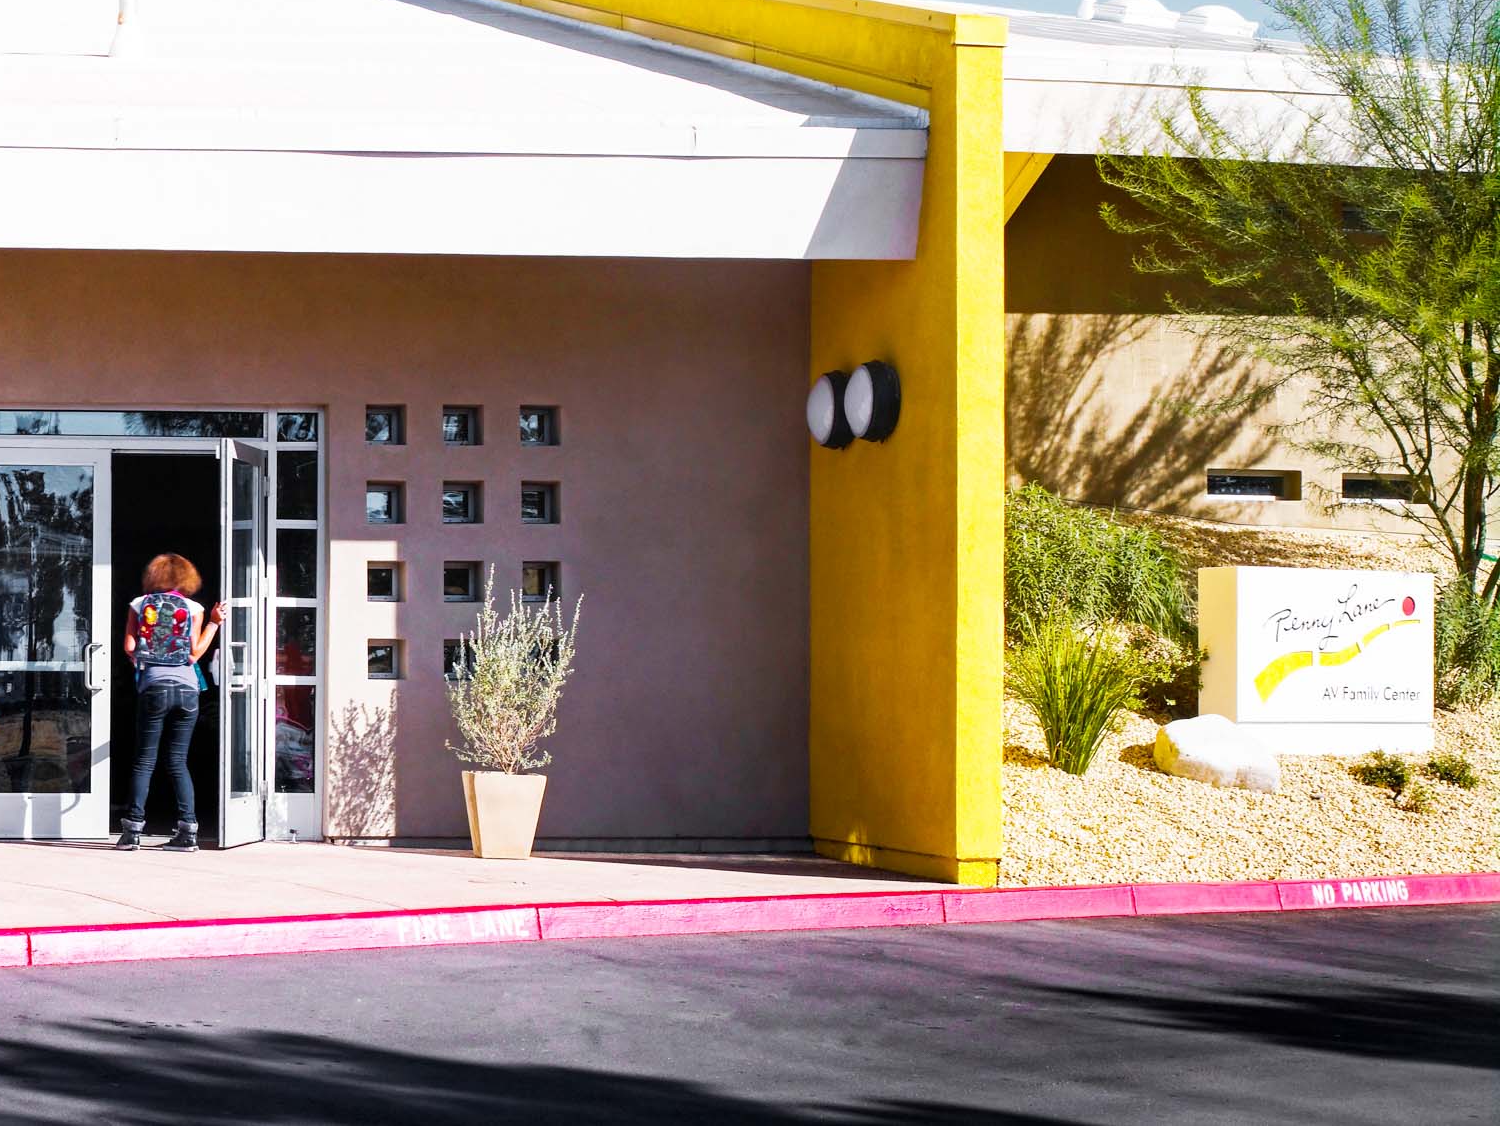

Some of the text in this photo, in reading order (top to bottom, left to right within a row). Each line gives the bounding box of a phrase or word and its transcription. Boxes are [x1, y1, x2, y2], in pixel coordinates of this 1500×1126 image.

[1263, 583, 1396, 651] Penny Lane
[1322, 685, 1421, 703] AV Family Center
[1311, 879, 1409, 906] NO PARKING
[399, 909, 530, 943] FIRE LANE
